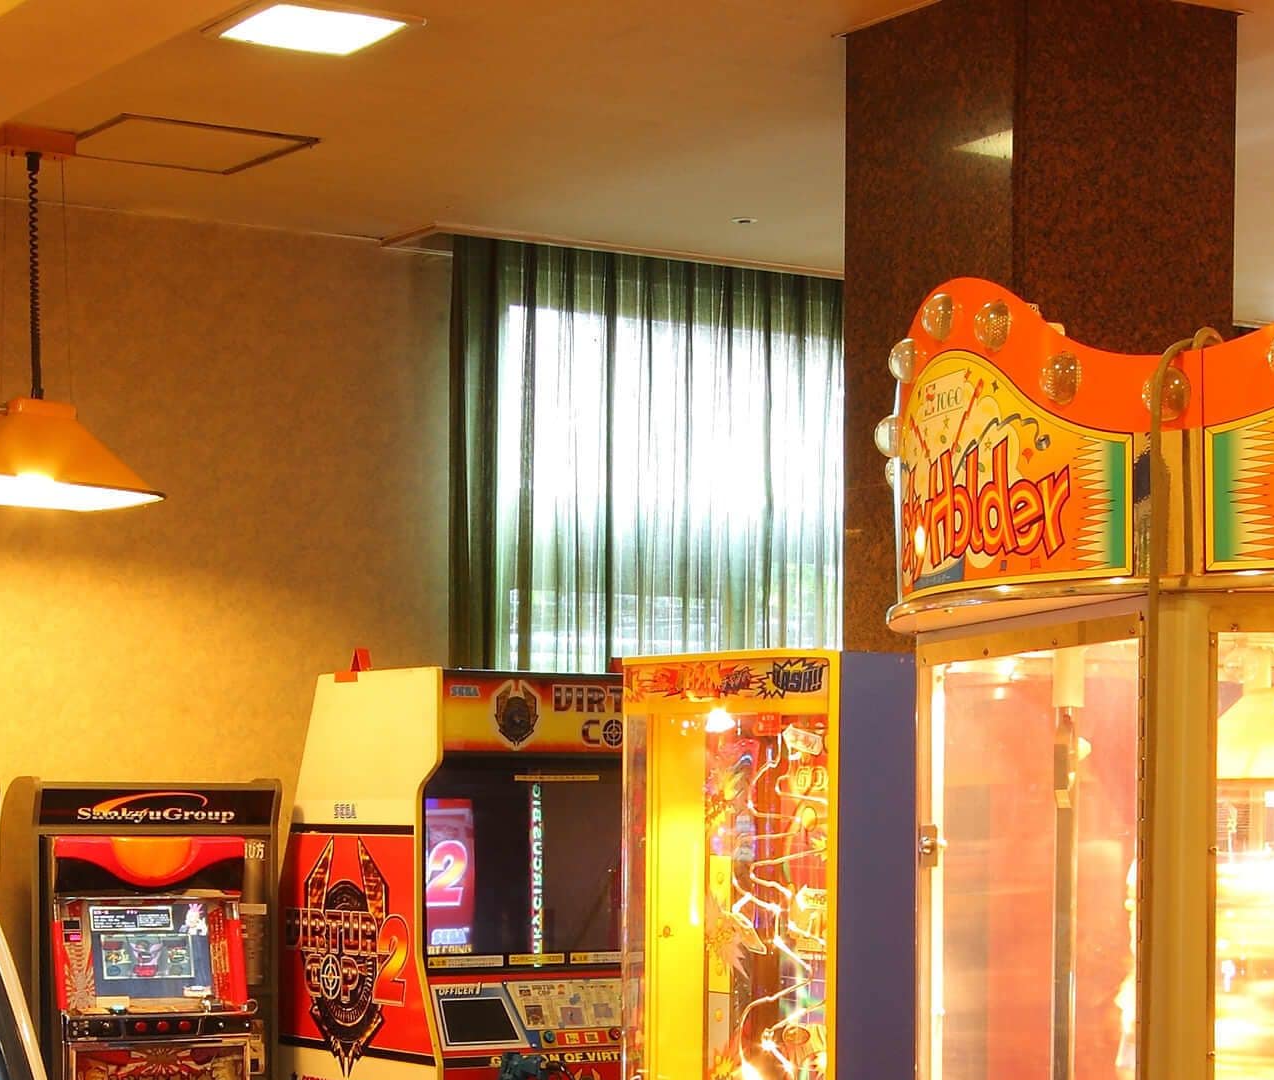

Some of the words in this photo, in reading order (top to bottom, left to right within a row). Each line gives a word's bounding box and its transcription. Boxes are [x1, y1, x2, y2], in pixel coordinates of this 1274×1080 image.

[926, 436, 1071, 569] Holder
[450, 685, 481, 698] SEGA
[552, 684, 623, 713] VIRT
[334, 803, 357, 819] SEGA
[426, 840, 468, 907] 2
[286, 908, 378, 956] VIRTUA
[303, 953, 360, 1002] COP
[372, 913, 410, 1007] 2
[438, 988, 474, 997] OFFICER
[564, 1053, 584, 1063] OF
